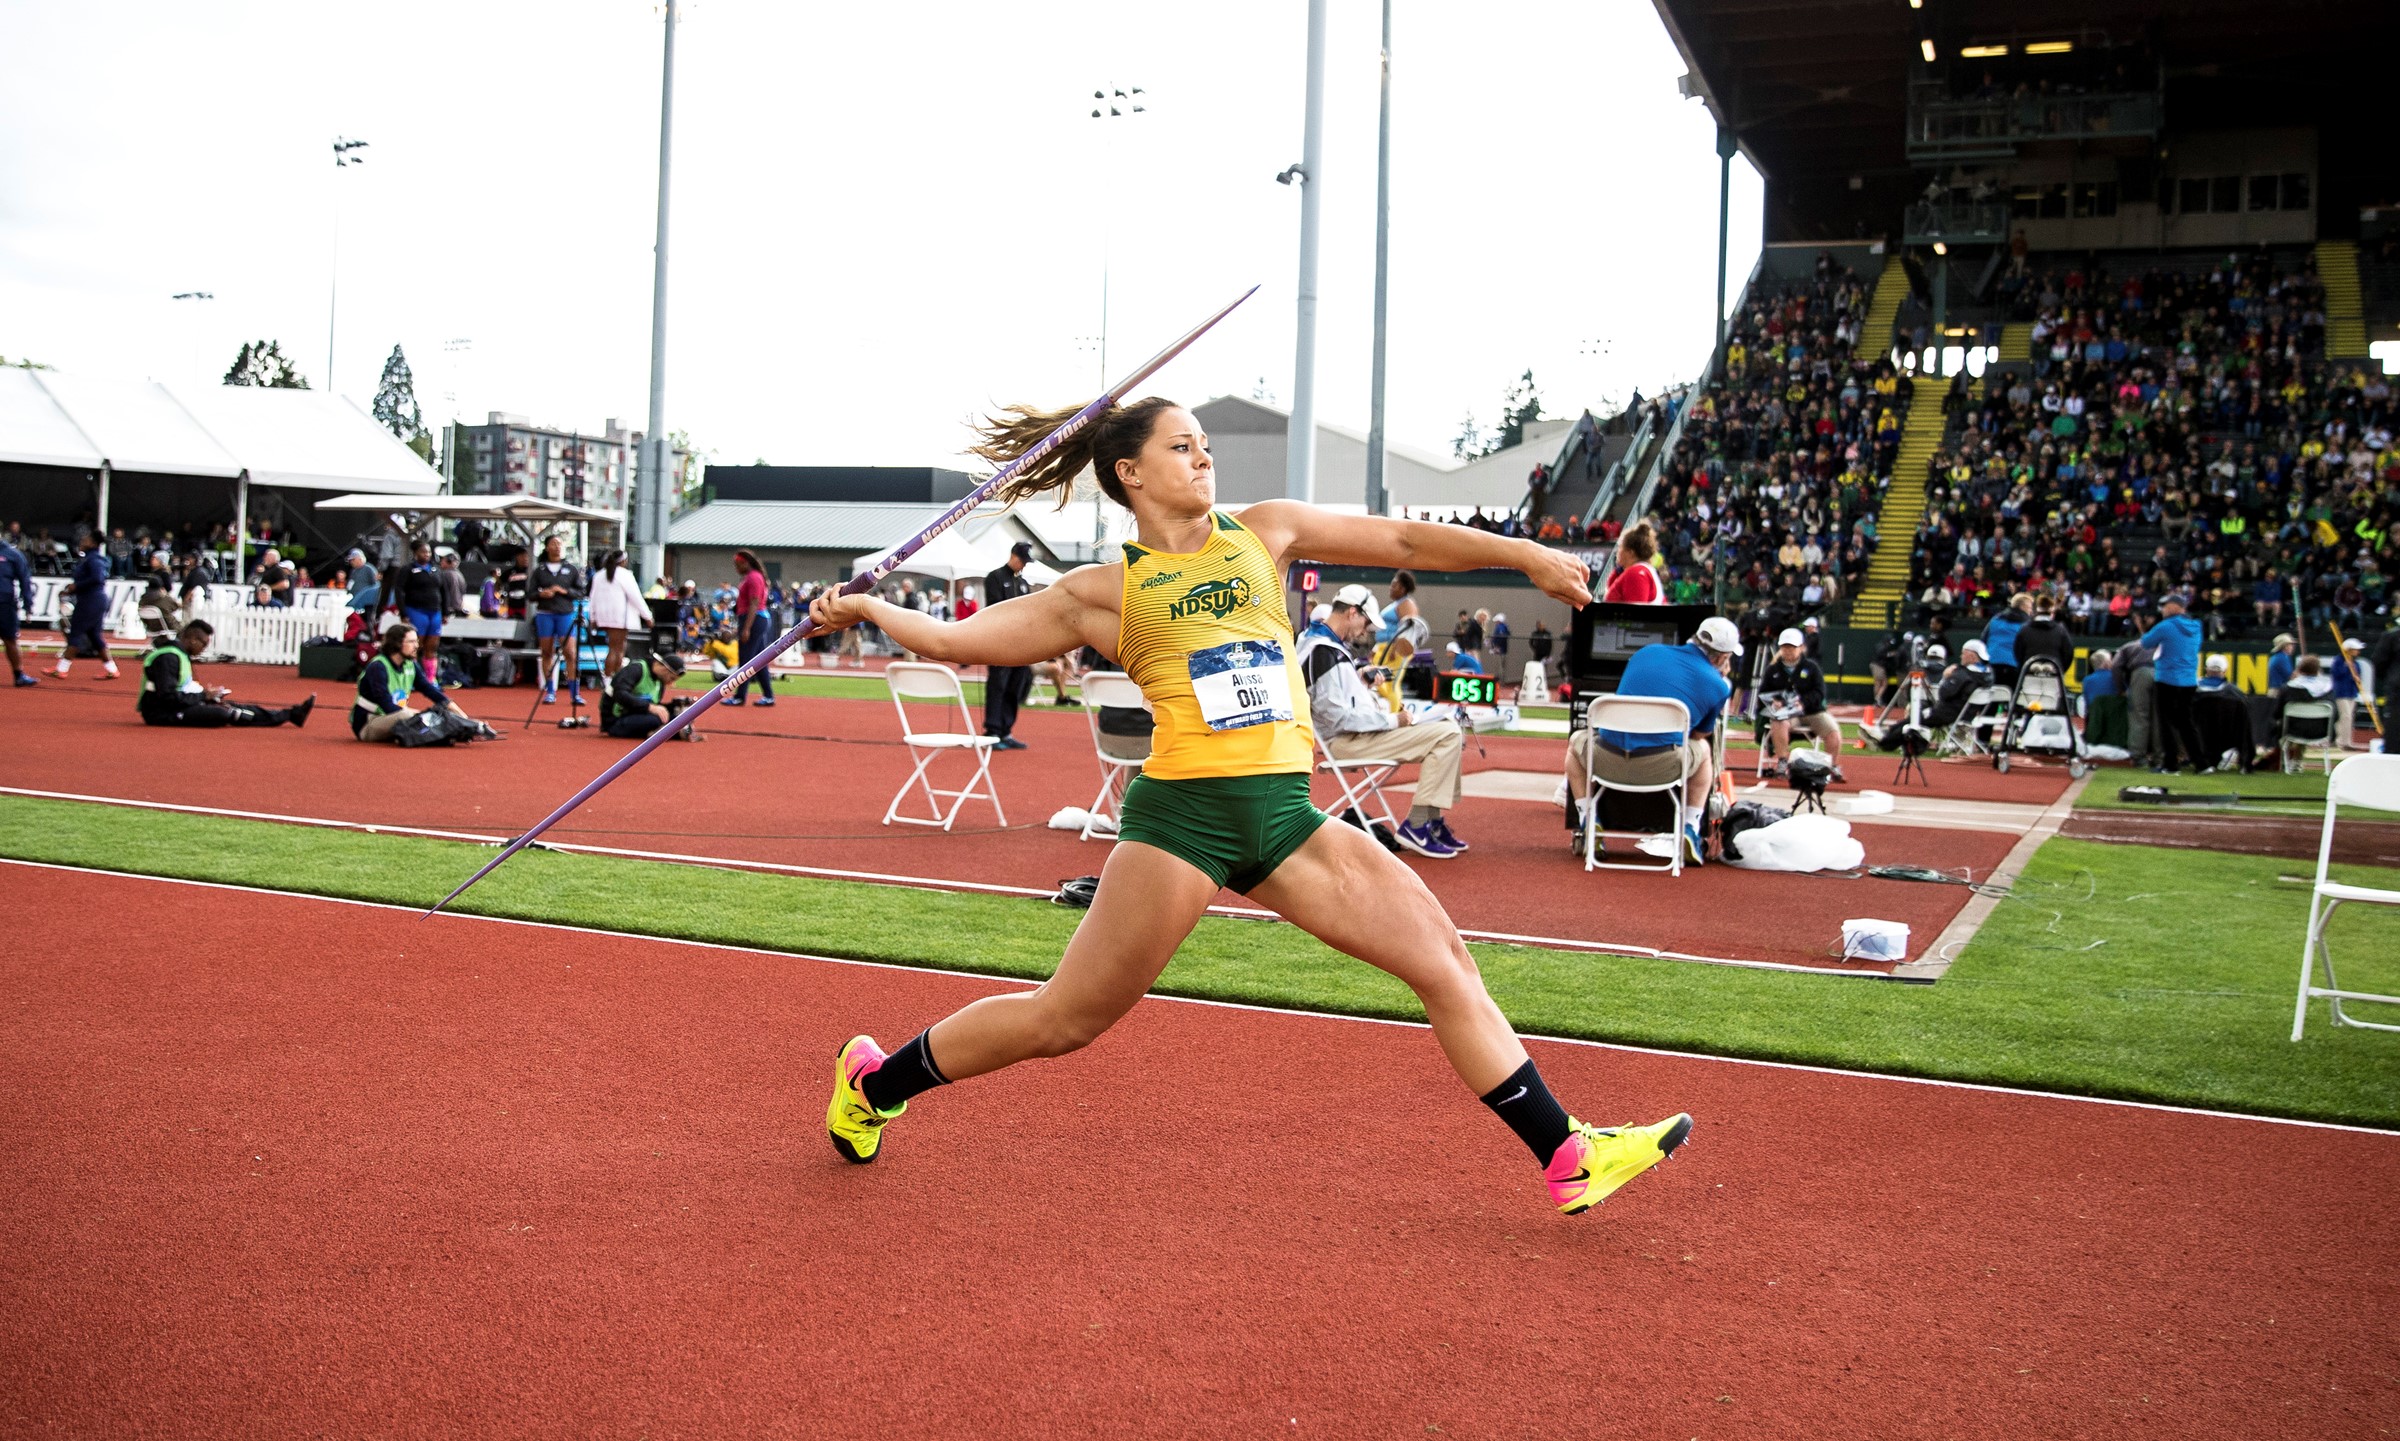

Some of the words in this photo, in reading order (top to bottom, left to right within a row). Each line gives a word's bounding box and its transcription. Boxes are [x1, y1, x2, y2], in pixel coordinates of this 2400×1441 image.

[921, 495, 979, 545] Nemeth
[982, 440, 1052, 500] standard
[1054, 415, 1089, 444] 70m
[1140, 571, 1183, 590] SUMMIT
[1303, 571, 1317, 591] 0
[1169, 590, 1231, 621] NDSU
[1452, 677, 1494, 703] 0:51
